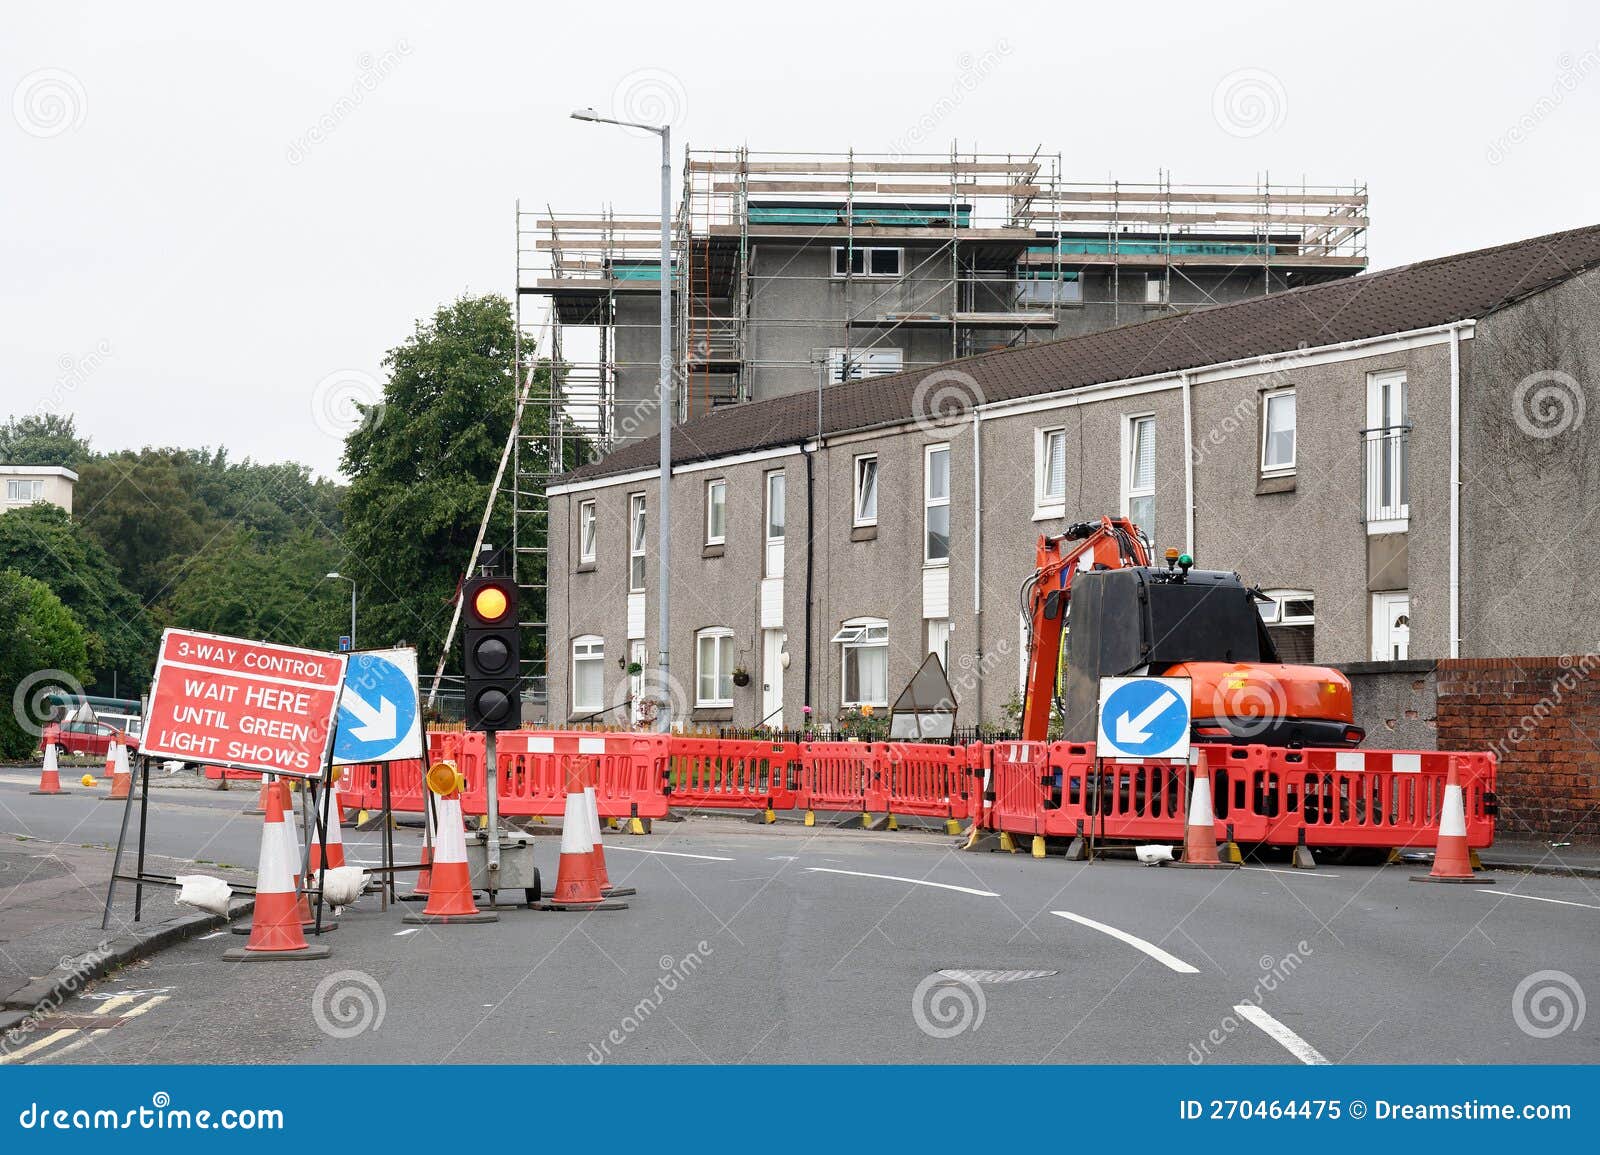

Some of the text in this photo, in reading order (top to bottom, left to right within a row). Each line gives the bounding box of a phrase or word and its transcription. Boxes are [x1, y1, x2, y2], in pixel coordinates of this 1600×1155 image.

[177, 642, 326, 679] 3-WAY CONTROL
[184, 679, 311, 715] WAIT HERE
[173, 705, 310, 743] UNTIL GREEN
[159, 730, 311, 769] LIGHT SHOWS
